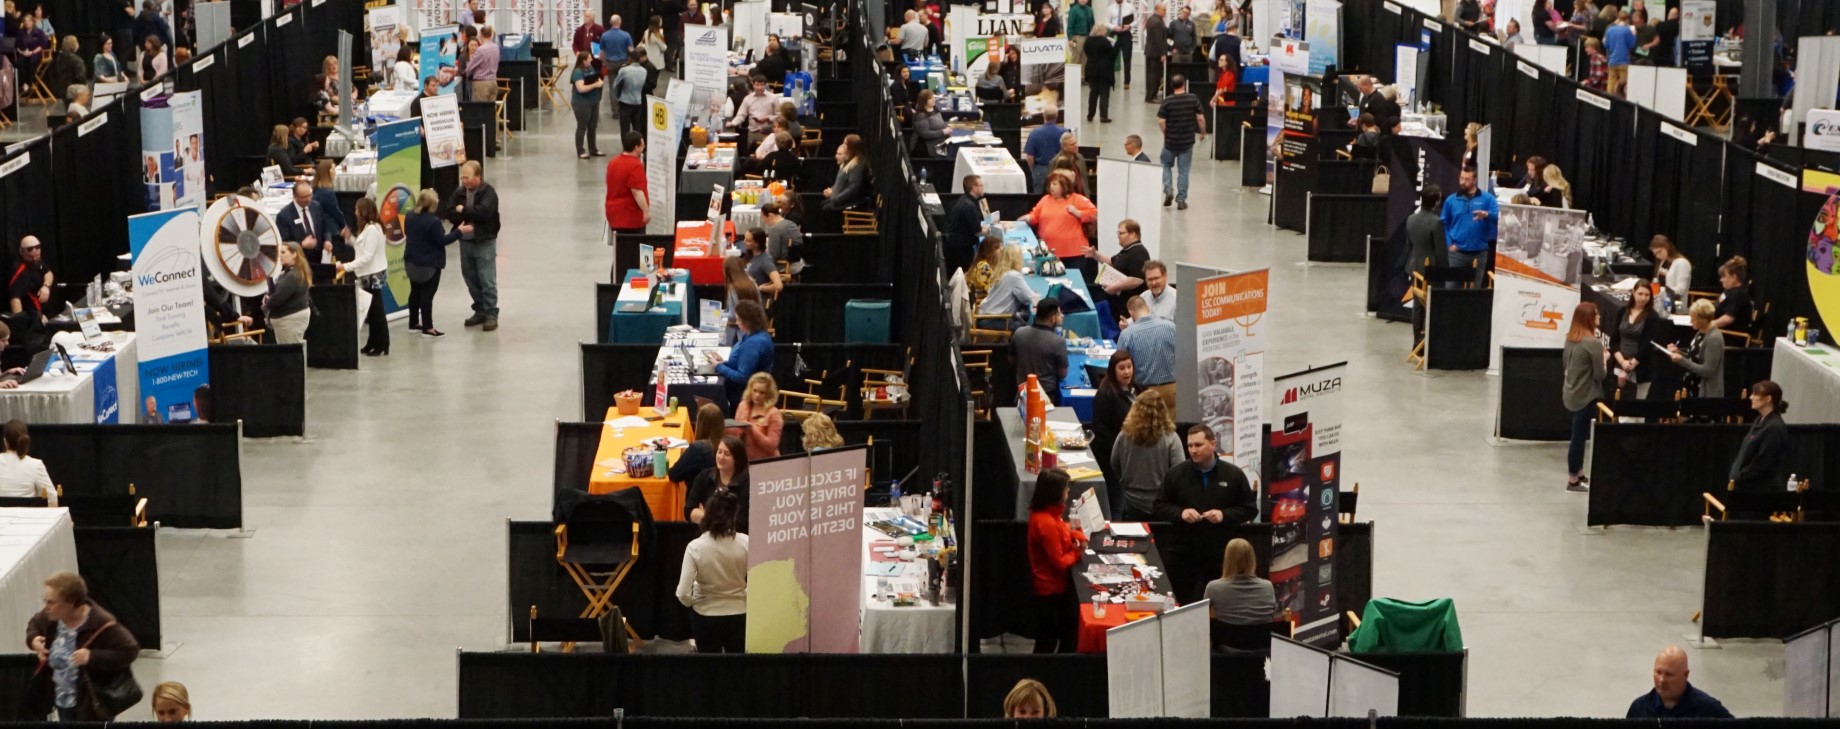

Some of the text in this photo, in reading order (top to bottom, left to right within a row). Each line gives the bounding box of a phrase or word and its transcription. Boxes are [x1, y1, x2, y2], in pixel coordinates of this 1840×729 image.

[1022, 44, 1063, 53] LUVATA
[1416, 147, 1425, 191] LIMIT
[138, 267, 195, 286] WeConnect
[1202, 282, 1226, 298] JOIN
[175, 299, 194, 309] Team!
[1202, 288, 1264, 308] LSC COMMUNICATIONS
[1202, 307, 1222, 319] TODAY!
[152, 333, 174, 342] Company
[1202, 336, 1227, 346] EXPERIENCE
[145, 365, 169, 377] NOW
[1300, 377, 1341, 396] MUZA
